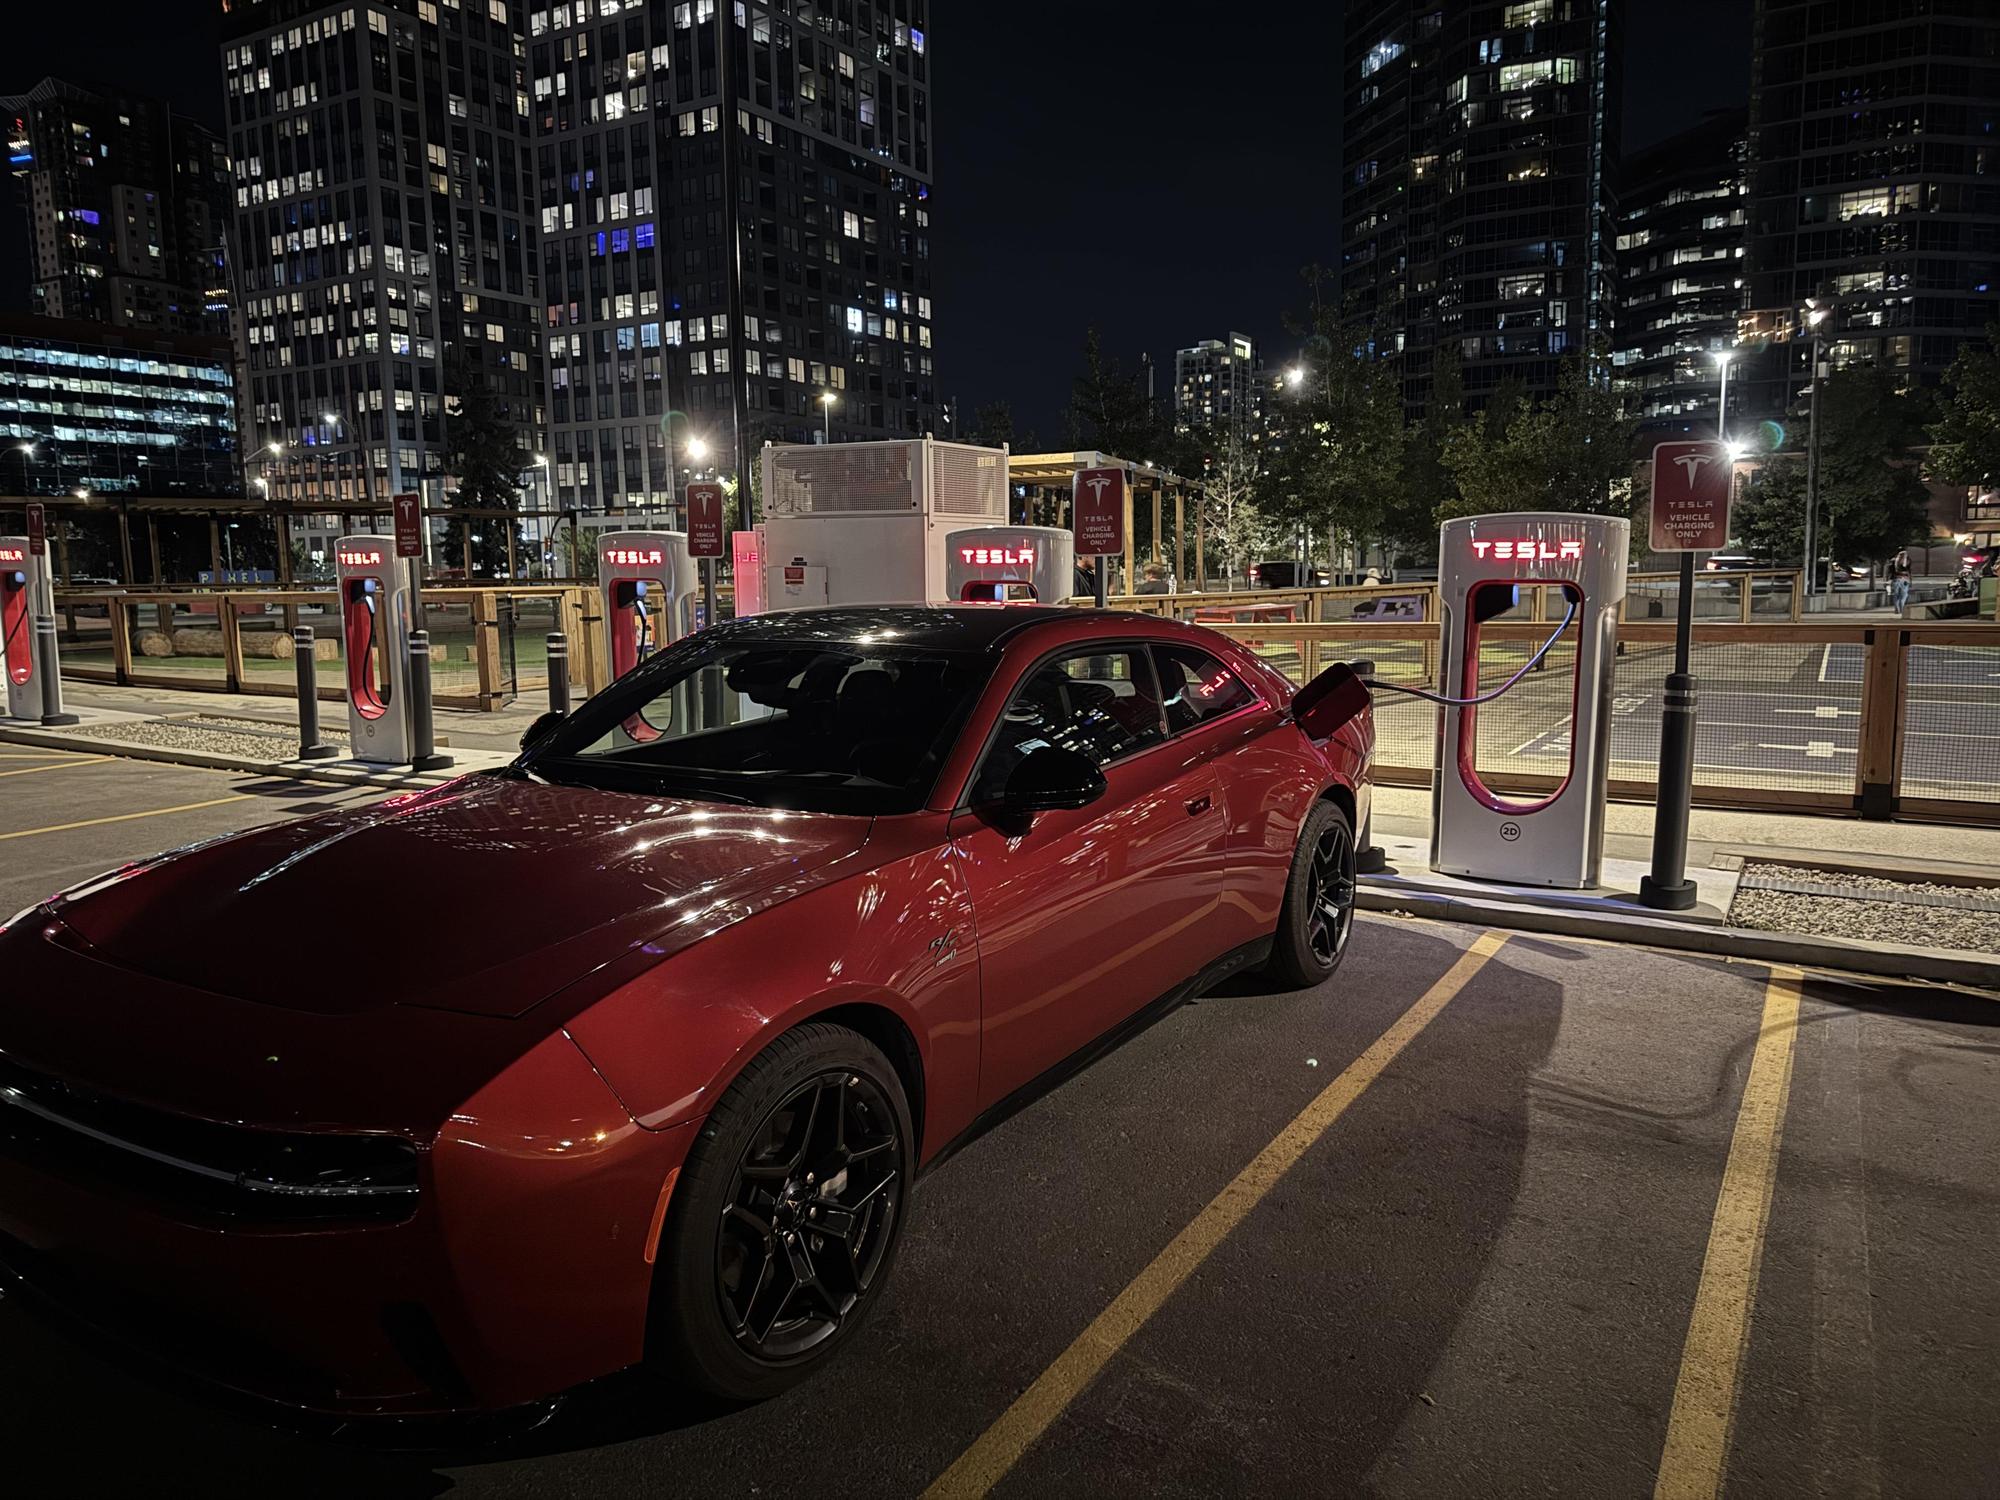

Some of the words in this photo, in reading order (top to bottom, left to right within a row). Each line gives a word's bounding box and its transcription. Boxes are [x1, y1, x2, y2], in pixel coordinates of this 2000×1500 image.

[1669, 514, 1711, 522] VEHICLE
[1664, 522, 1715, 530] CHARGING
[1676, 530, 1702, 539] ONLY
[1473, 541, 1583, 559] TESLA
[340, 552, 381, 565] TESLA
[607, 551, 662, 564] TESLA
[961, 549, 1034, 565] TESLA
[201, 572, 262, 584] PXEL
[1503, 827, 1518, 836] 2D
